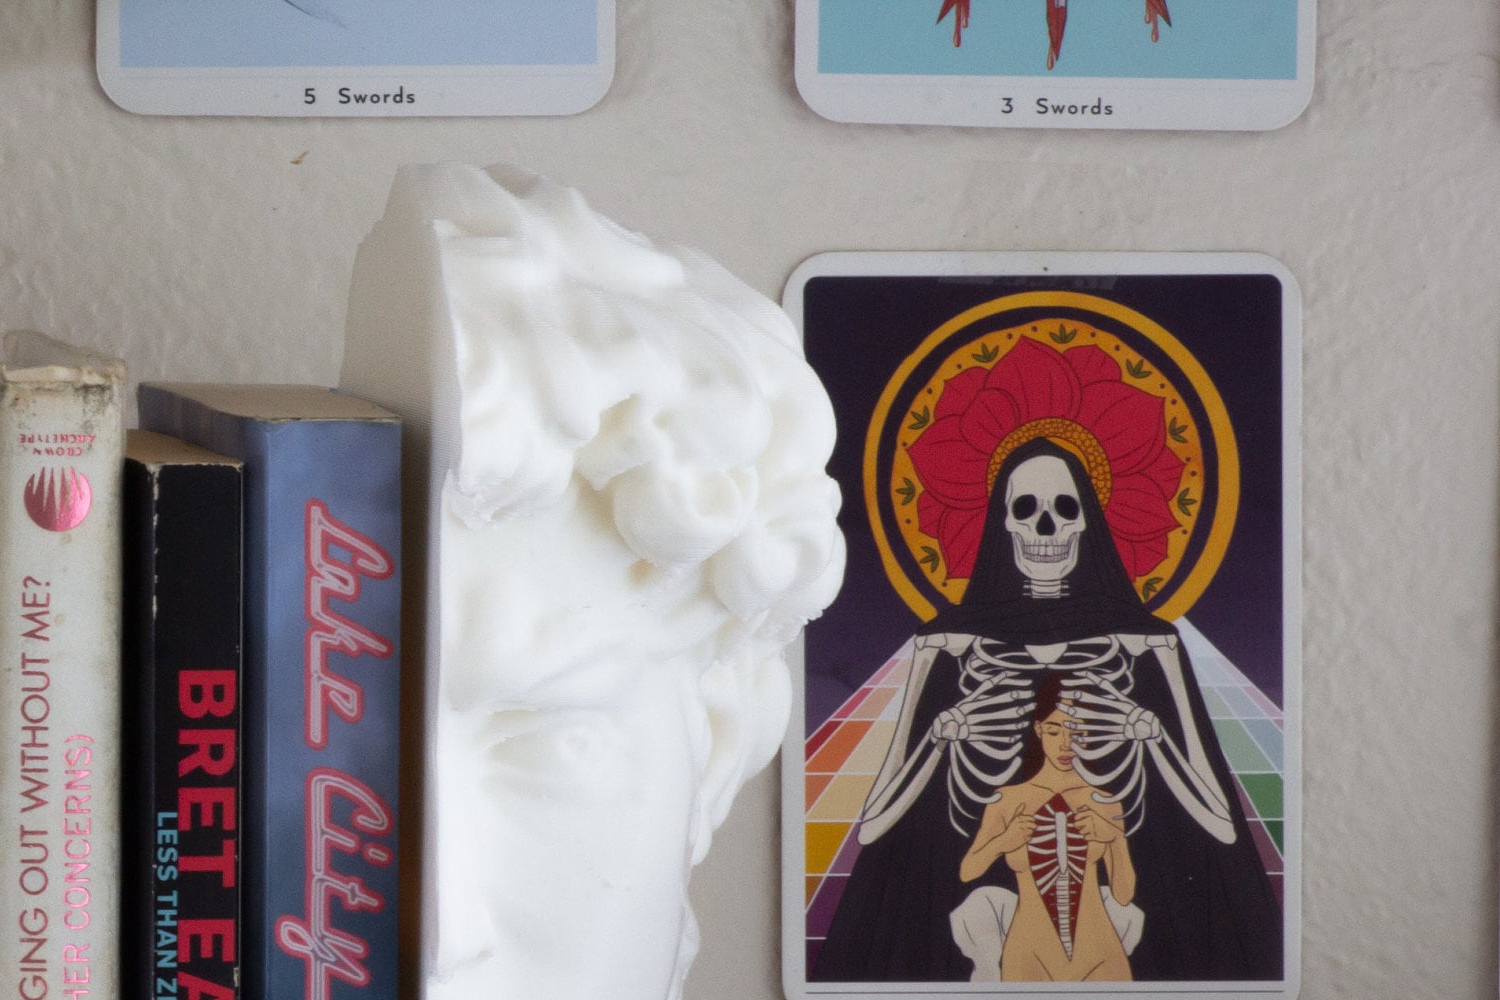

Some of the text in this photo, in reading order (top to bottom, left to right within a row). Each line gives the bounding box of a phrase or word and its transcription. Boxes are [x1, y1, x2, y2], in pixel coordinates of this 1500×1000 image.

[303, 85, 416, 105] 5 Swords
[1001, 96, 1114, 115] 3 Swords
[19, 433, 96, 443] ARCHETYPE
[32, 447, 83, 457] CROWN
[20, 574, 51, 643] ME?
[304, 498, 395, 750] Lake
[19, 651, 51, 814] WITHOUT
[176, 669, 237, 889] BRET
[18, 823, 49, 897] OUT
[62, 733, 95, 931] CONCERNS)
[156, 811, 179, 882] LESS
[156, 890, 179, 969] THAN
